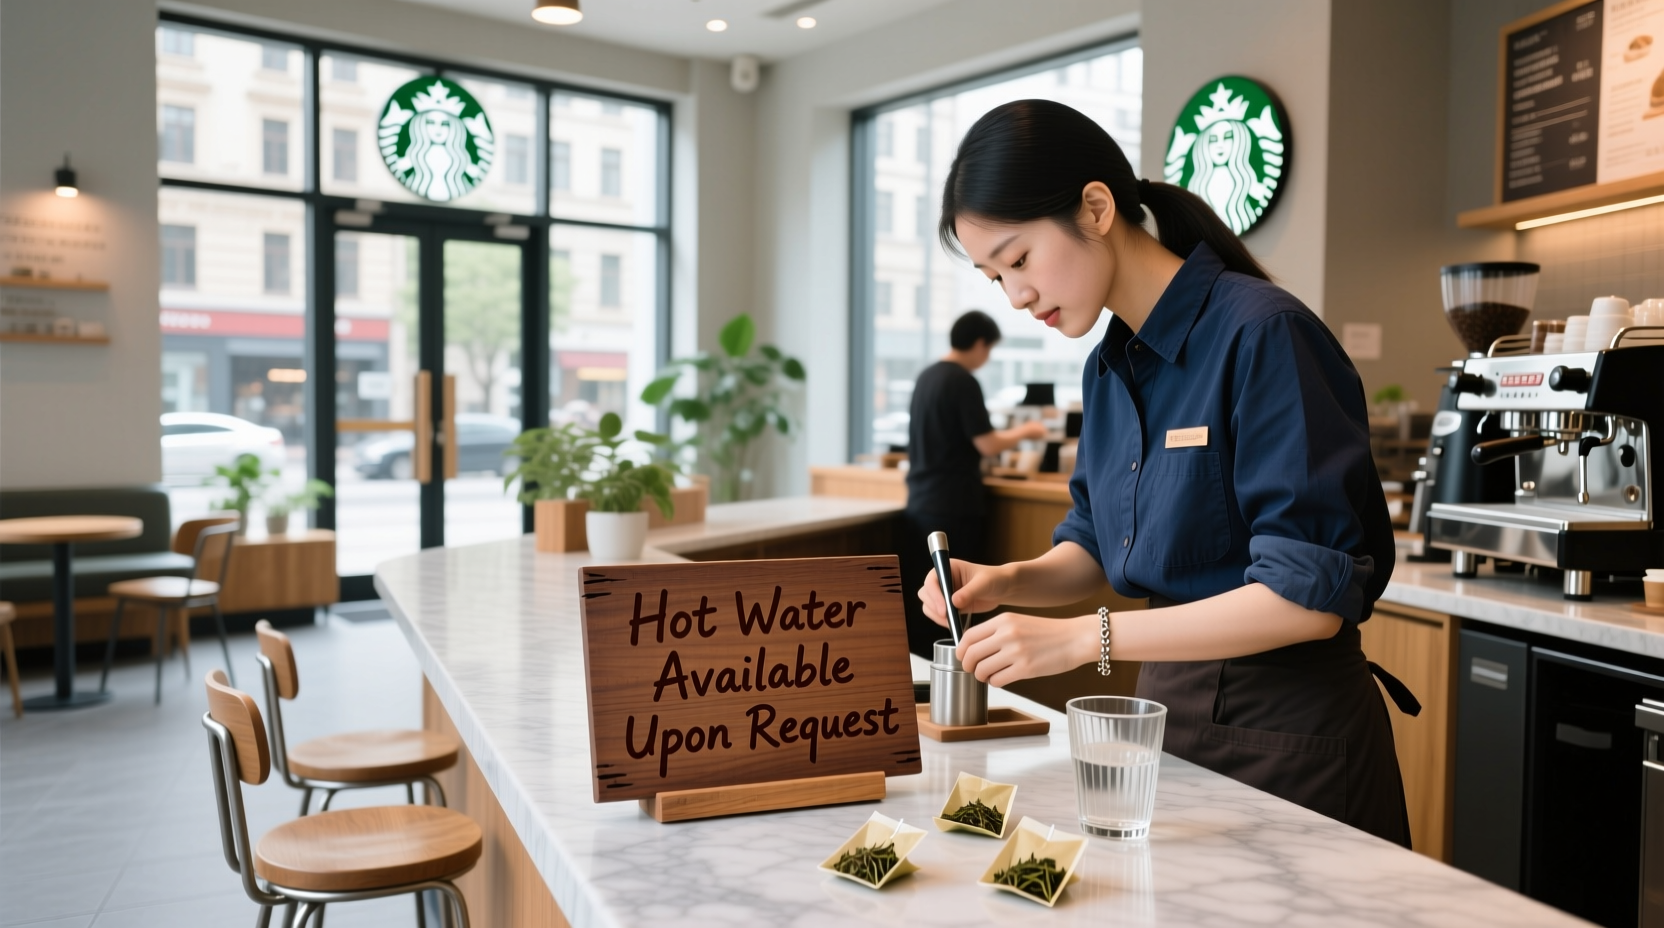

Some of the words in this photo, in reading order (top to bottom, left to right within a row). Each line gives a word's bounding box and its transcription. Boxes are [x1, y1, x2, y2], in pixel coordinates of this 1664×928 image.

[629, 589, 717, 646] Hot
[735, 585, 866, 636] Water
[653, 642, 854, 702] Available
[625, 714, 733, 778] Upon
[745, 697, 900, 764] Request
